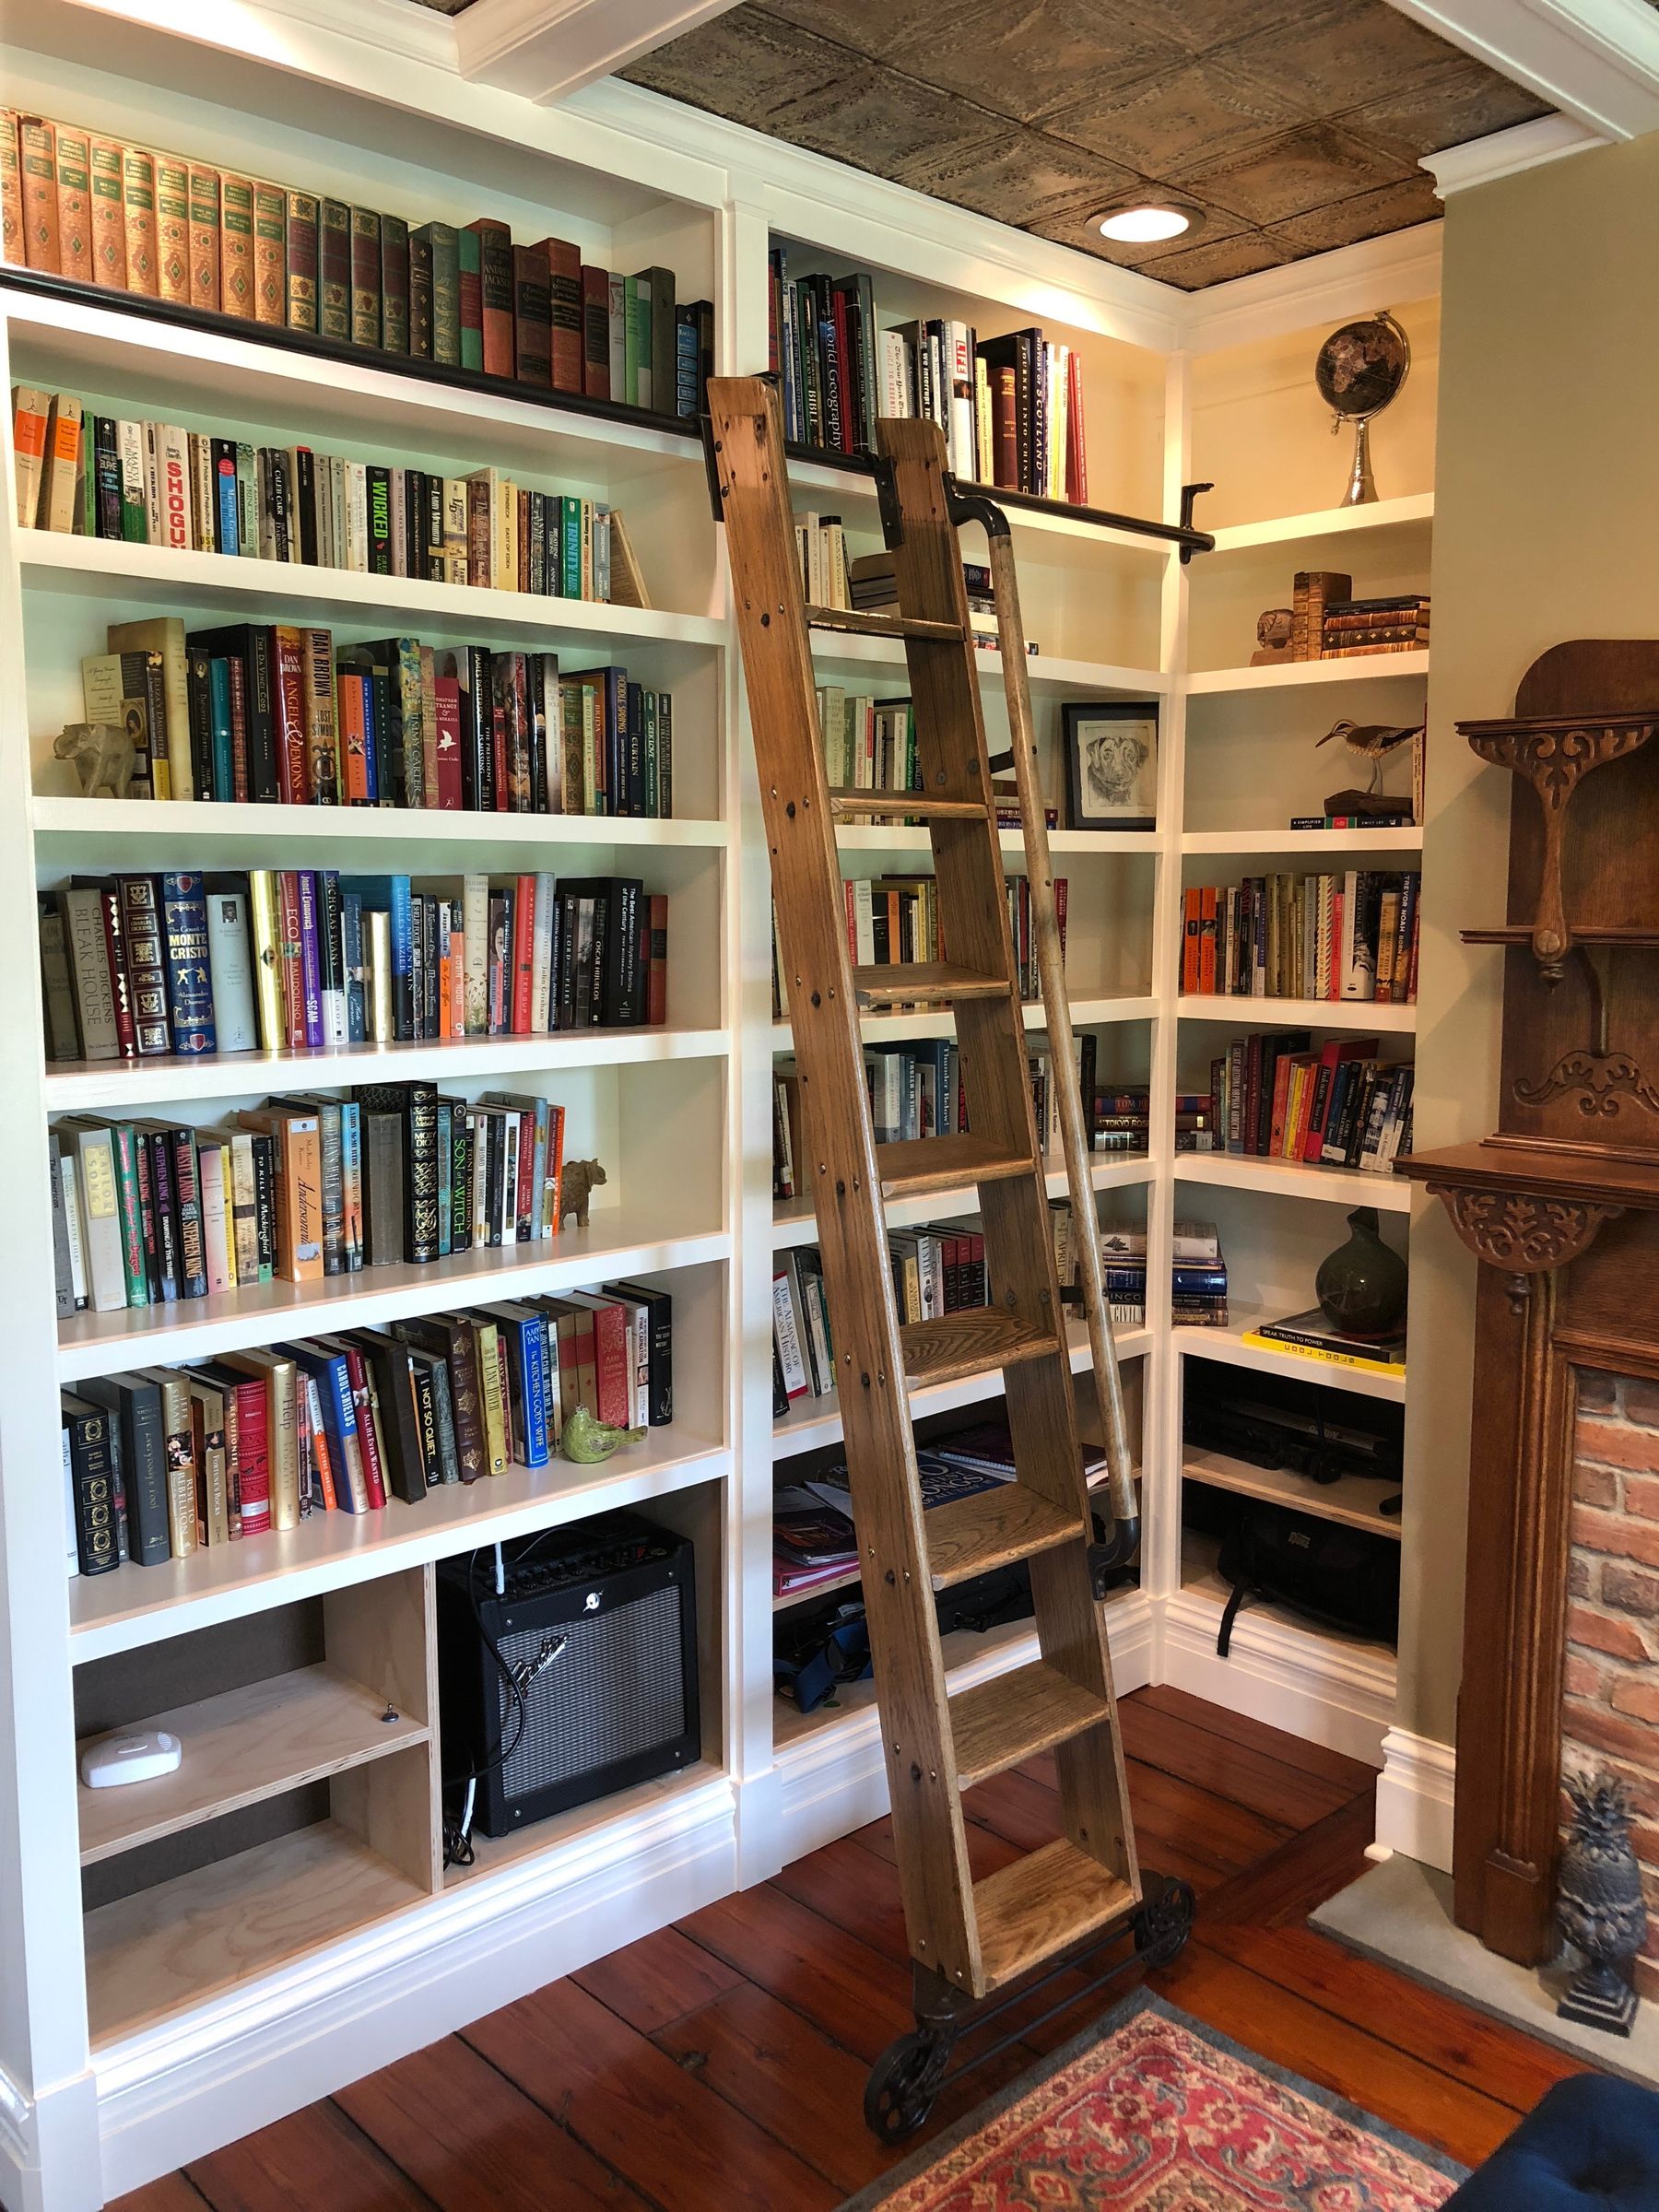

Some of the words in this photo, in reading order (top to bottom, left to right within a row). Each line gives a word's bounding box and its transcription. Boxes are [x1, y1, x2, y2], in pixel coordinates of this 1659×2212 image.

[826, 319, 838, 363] World
[955, 340, 968, 374] LIFE
[808, 390, 818, 426] BIBLE
[827, 369, 842, 450] Geography
[372, 482, 388, 538] WICKED
[567, 522, 579, 573] TRINITY
[284, 654, 299, 663] DAN
[312, 634, 328, 655] DAN
[259, 655, 265, 665] DA
[313, 659, 331, 698] BROWN
[618, 676, 626, 703] POODLE
[287, 678, 300, 724] ANGELS
[410, 713, 419, 748] JIMMY
[618, 706, 627, 734] SPRINGS
[290, 743, 302, 788] DEMONS
[412, 750, 422, 792] CARTER
[301, 875, 311, 896] Janet
[1401, 876, 1410, 907] TREVOR
[302, 896, 313, 930] Evanovich
[327, 876, 337, 930] NICHOLAS
[397, 887, 406, 929] CHARLES
[413, 906, 421, 926] SHELBY
[75, 909, 90, 961] BLEAK
[287, 908, 299, 939] ECO
[1399, 909, 1407, 932] NOAH
[169, 933, 207, 947] MONTE
[170, 947, 207, 959] CRISTO
[331, 932, 339, 967] EVANS
[92, 907, 105, 963] CHARLES
[100, 971, 113, 1024] DICKENS
[503, 954, 512, 991] DUSTIN
[82, 969, 101, 1024] HOUSE
[292, 961, 300, 1021] BAUDOLINO
[593, 967, 601, 1001] HIJUELOS
[307, 1000, 319, 1023] SCAM
[539, 986, 547, 1020] Grisham
[909, 1090, 915, 1099] IN
[323, 1112, 340, 1137] DEAD
[349, 1107, 358, 1128] LARRY
[414, 1130, 436, 1139] MOBY
[416, 1138, 435, 1147] DICK
[137, 1148, 147, 1181] STEPHEN
[155, 1146, 168, 1181] STEPHEN
[176, 1144, 192, 1173] WASTE
[258, 1156, 265, 1167] TO
[324, 1138, 340, 1164] MAN'S
[454, 1139, 465, 1169] SON
[88, 1160, 100, 1202] SONG
[99, 1150, 113, 1210] SAILOR
[177, 1176, 196, 1204] LANDS
[324, 1165, 340, 1189] WALK
[456, 1171, 464, 1181] of
[51, 1175, 60, 1208] American
[139, 1182, 149, 1202] KING
[158, 1182, 169, 1201] KING
[324, 1194, 339, 1214] Larry
[297, 1176, 317, 1246] Andersonvill
[453, 1185, 465, 1234] WITCH
[162, 1217, 171, 1241] DRAWING
[182, 1220, 199, 1256] STEPHEN
[258, 1204, 269, 1254] Mockingbird
[324, 1215, 339, 1251] McMurtry
[186, 1257, 202, 1278] KING
[1057, 1240, 1067, 1267] APRIL
[166, 1260, 174, 1279] THREE
[1057, 1274, 1066, 1287] 18
[781, 1283, 791, 1306] THE
[1111, 1292, 1142, 1301] INCO
[525, 1327, 542, 1338] AMY
[526, 1335, 541, 1346] TAN
[773, 1286, 787, 1332] AMERICAN
[782, 1335, 792, 1374] HISTORY
[784, 1309, 797, 1351] ALMANAC
[1262, 1329, 1278, 1337] SPEAK
[1278, 1332, 1296, 1341] TRUTH
[1304, 1337, 1324, 1347] POWER
[793, 1353, 800, 1368] OF
[336, 1364, 349, 1392] CAROL
[531, 1360, 541, 1398] KITCHEN
[172, 1388, 182, 1434] SHAARA
[180, 1396, 189, 1419] JEFF
[341, 1393, 355, 1428] SHIELDS
[421, 1387, 431, 1409] NOT
[534, 1399, 543, 1425] GOD'S
[280, 1399, 294, 1430] Help
[424, 1412, 433, 1426] SO
[229, 1406, 239, 1466] REVISIONIST
[365, 1427, 372, 1438] HE
[367, 1439, 376, 1455] EVER
[425, 1428, 436, 1464] QUIET...
[535, 1426, 544, 1448] WIFE
[212, 1454, 220, 1492] FORTUNE'S
[370, 1455, 380, 1484] WANTED
[177, 1472, 190, 1535] REBELLION
[187, 1508, 195, 1523] TO
